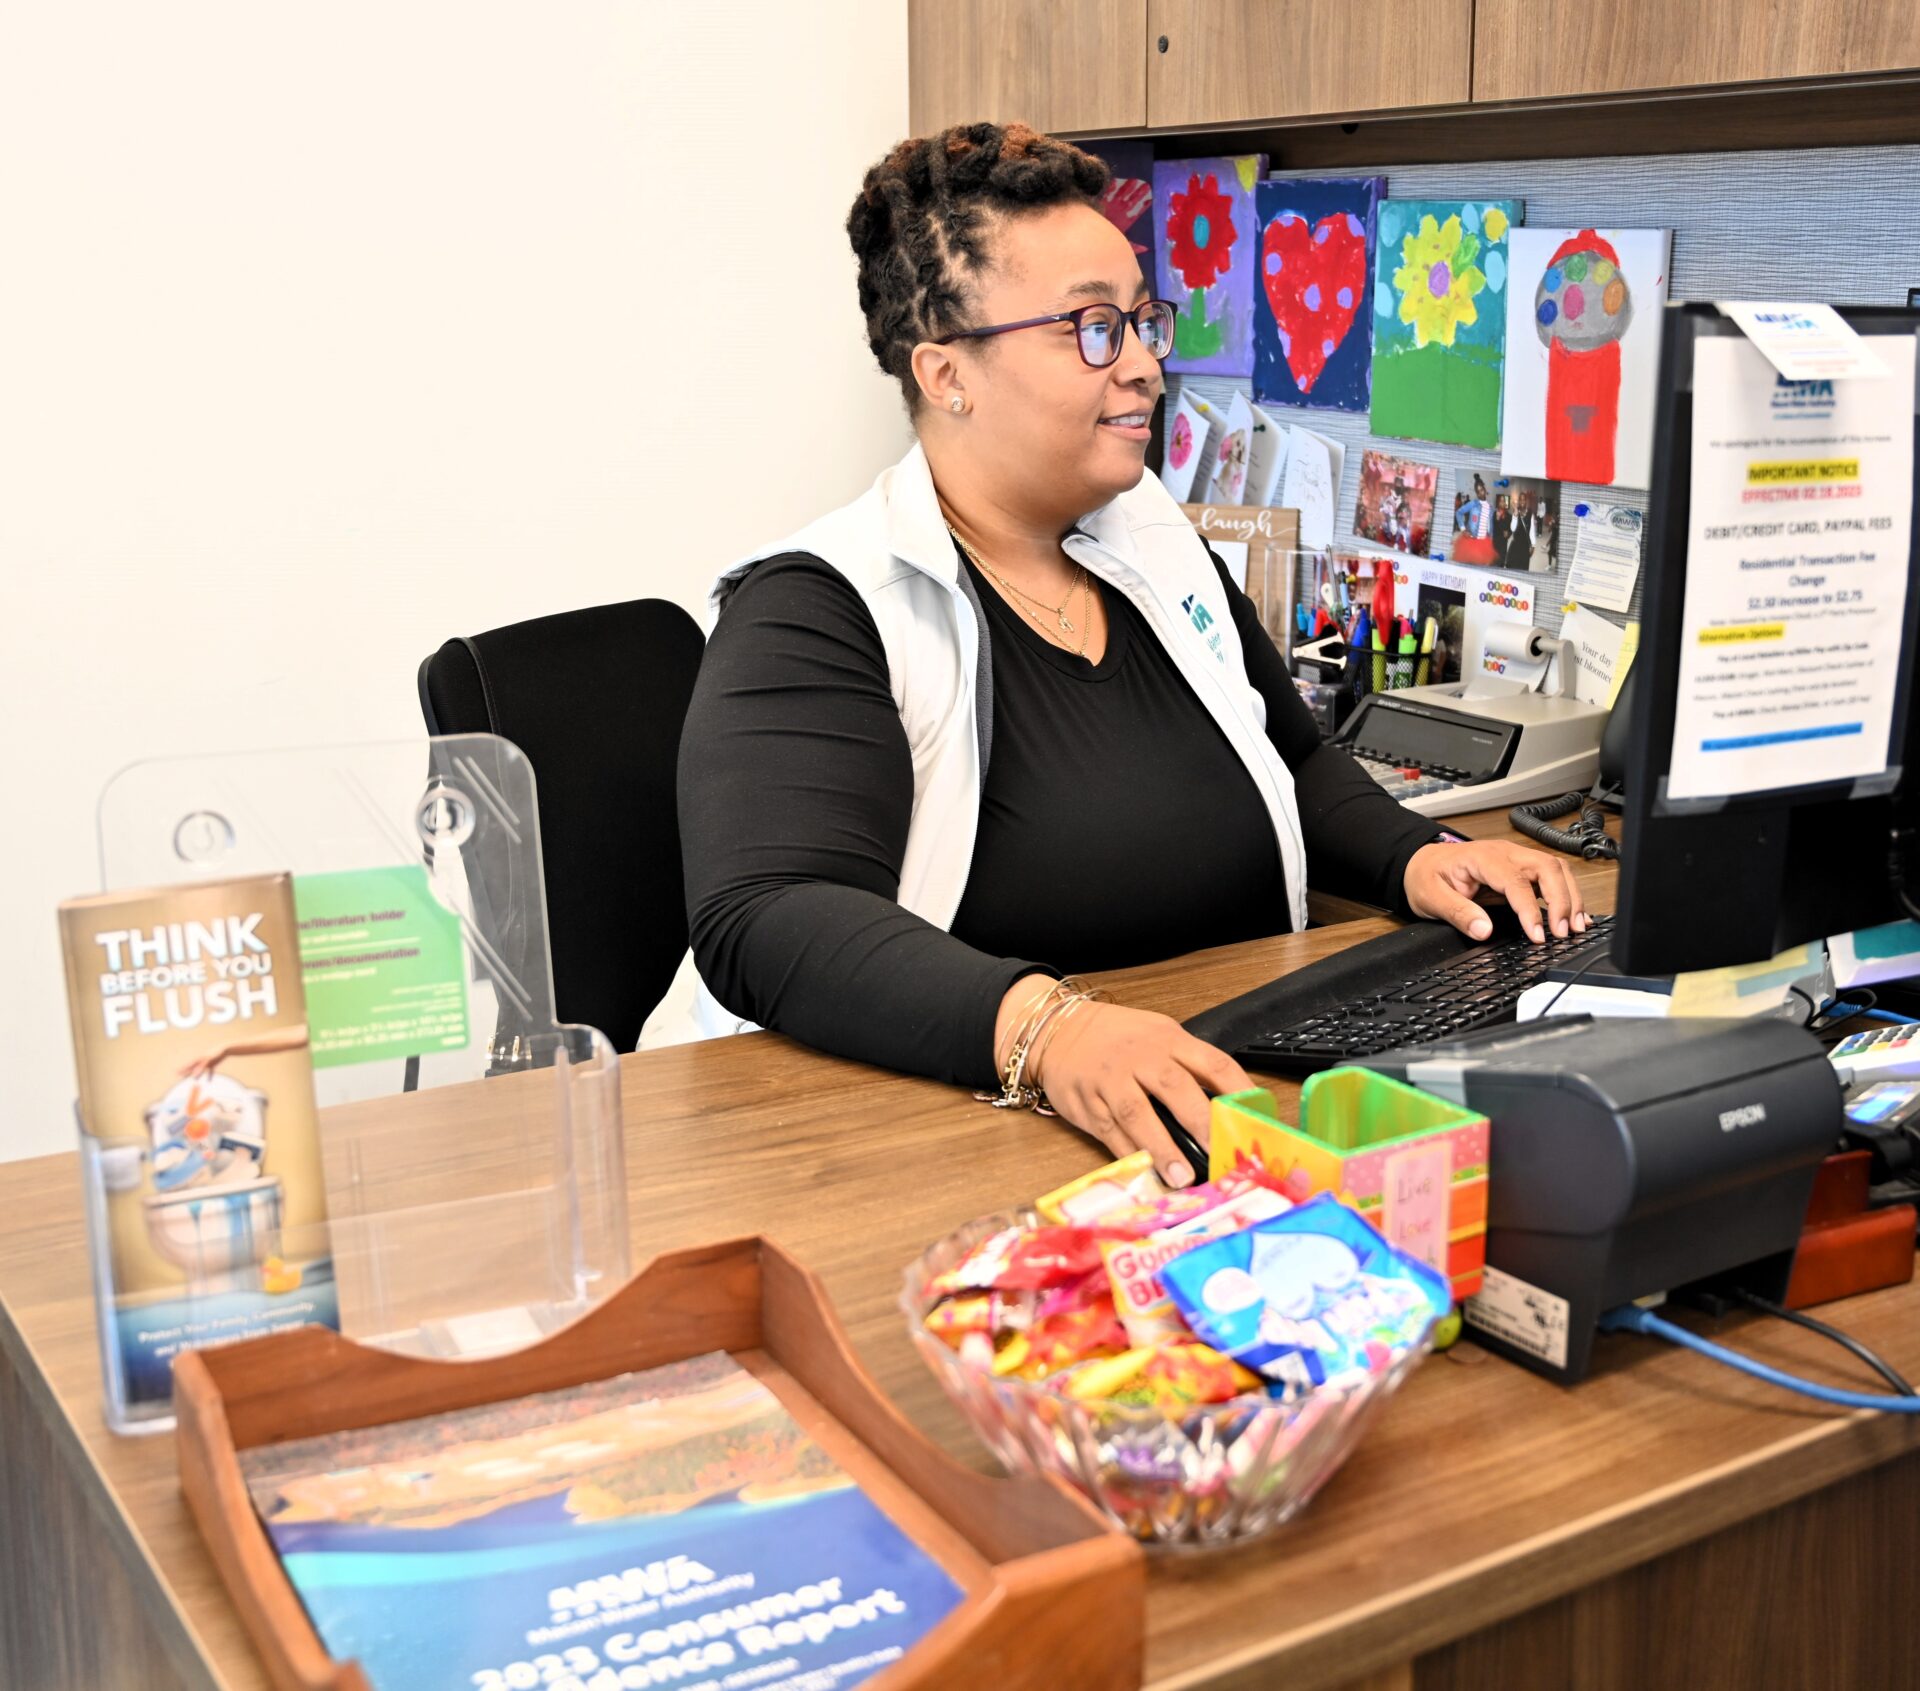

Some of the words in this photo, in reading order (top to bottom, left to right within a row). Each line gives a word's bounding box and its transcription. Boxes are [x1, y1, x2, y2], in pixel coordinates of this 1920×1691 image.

[1747, 465, 1816, 482] IMPORTANT
[1819, 462, 1859, 478] NOTICE
[1742, 487, 1799, 504] EFFECTIVE
[1197, 507, 1282, 540] laugh
[1705, 523, 1784, 541] DEBIT/CREDIT
[1788, 520, 1820, 535] CARD,
[1823, 518, 1866, 532] PAYPAL
[1868, 515, 1893, 529] FEES
[1739, 557, 1796, 571] Residential
[1799, 552, 1856, 567] Transaction
[1859, 550, 1876, 563] Fee
[1789, 575, 1827, 589] Change
[1779, 593, 1821, 608] increase
[1822, 592, 1834, 605] to
[1582, 640, 1599, 659] Your
[1599, 653, 1613, 669] day
[95, 912, 269, 972] THINK
[100, 960, 208, 997] BEFORE
[211, 951, 273, 980] YOU
[101, 974, 278, 1040] FLUSH
[1719, 1103, 1766, 1132] EPSON
[1397, 1176, 1432, 1205] Live
[661, 1571, 755, 1609] Authority
[470, 1645, 601, 1691] 2023
[602, 1576, 843, 1662] Consumer
[734, 1587, 907, 1656] Report
